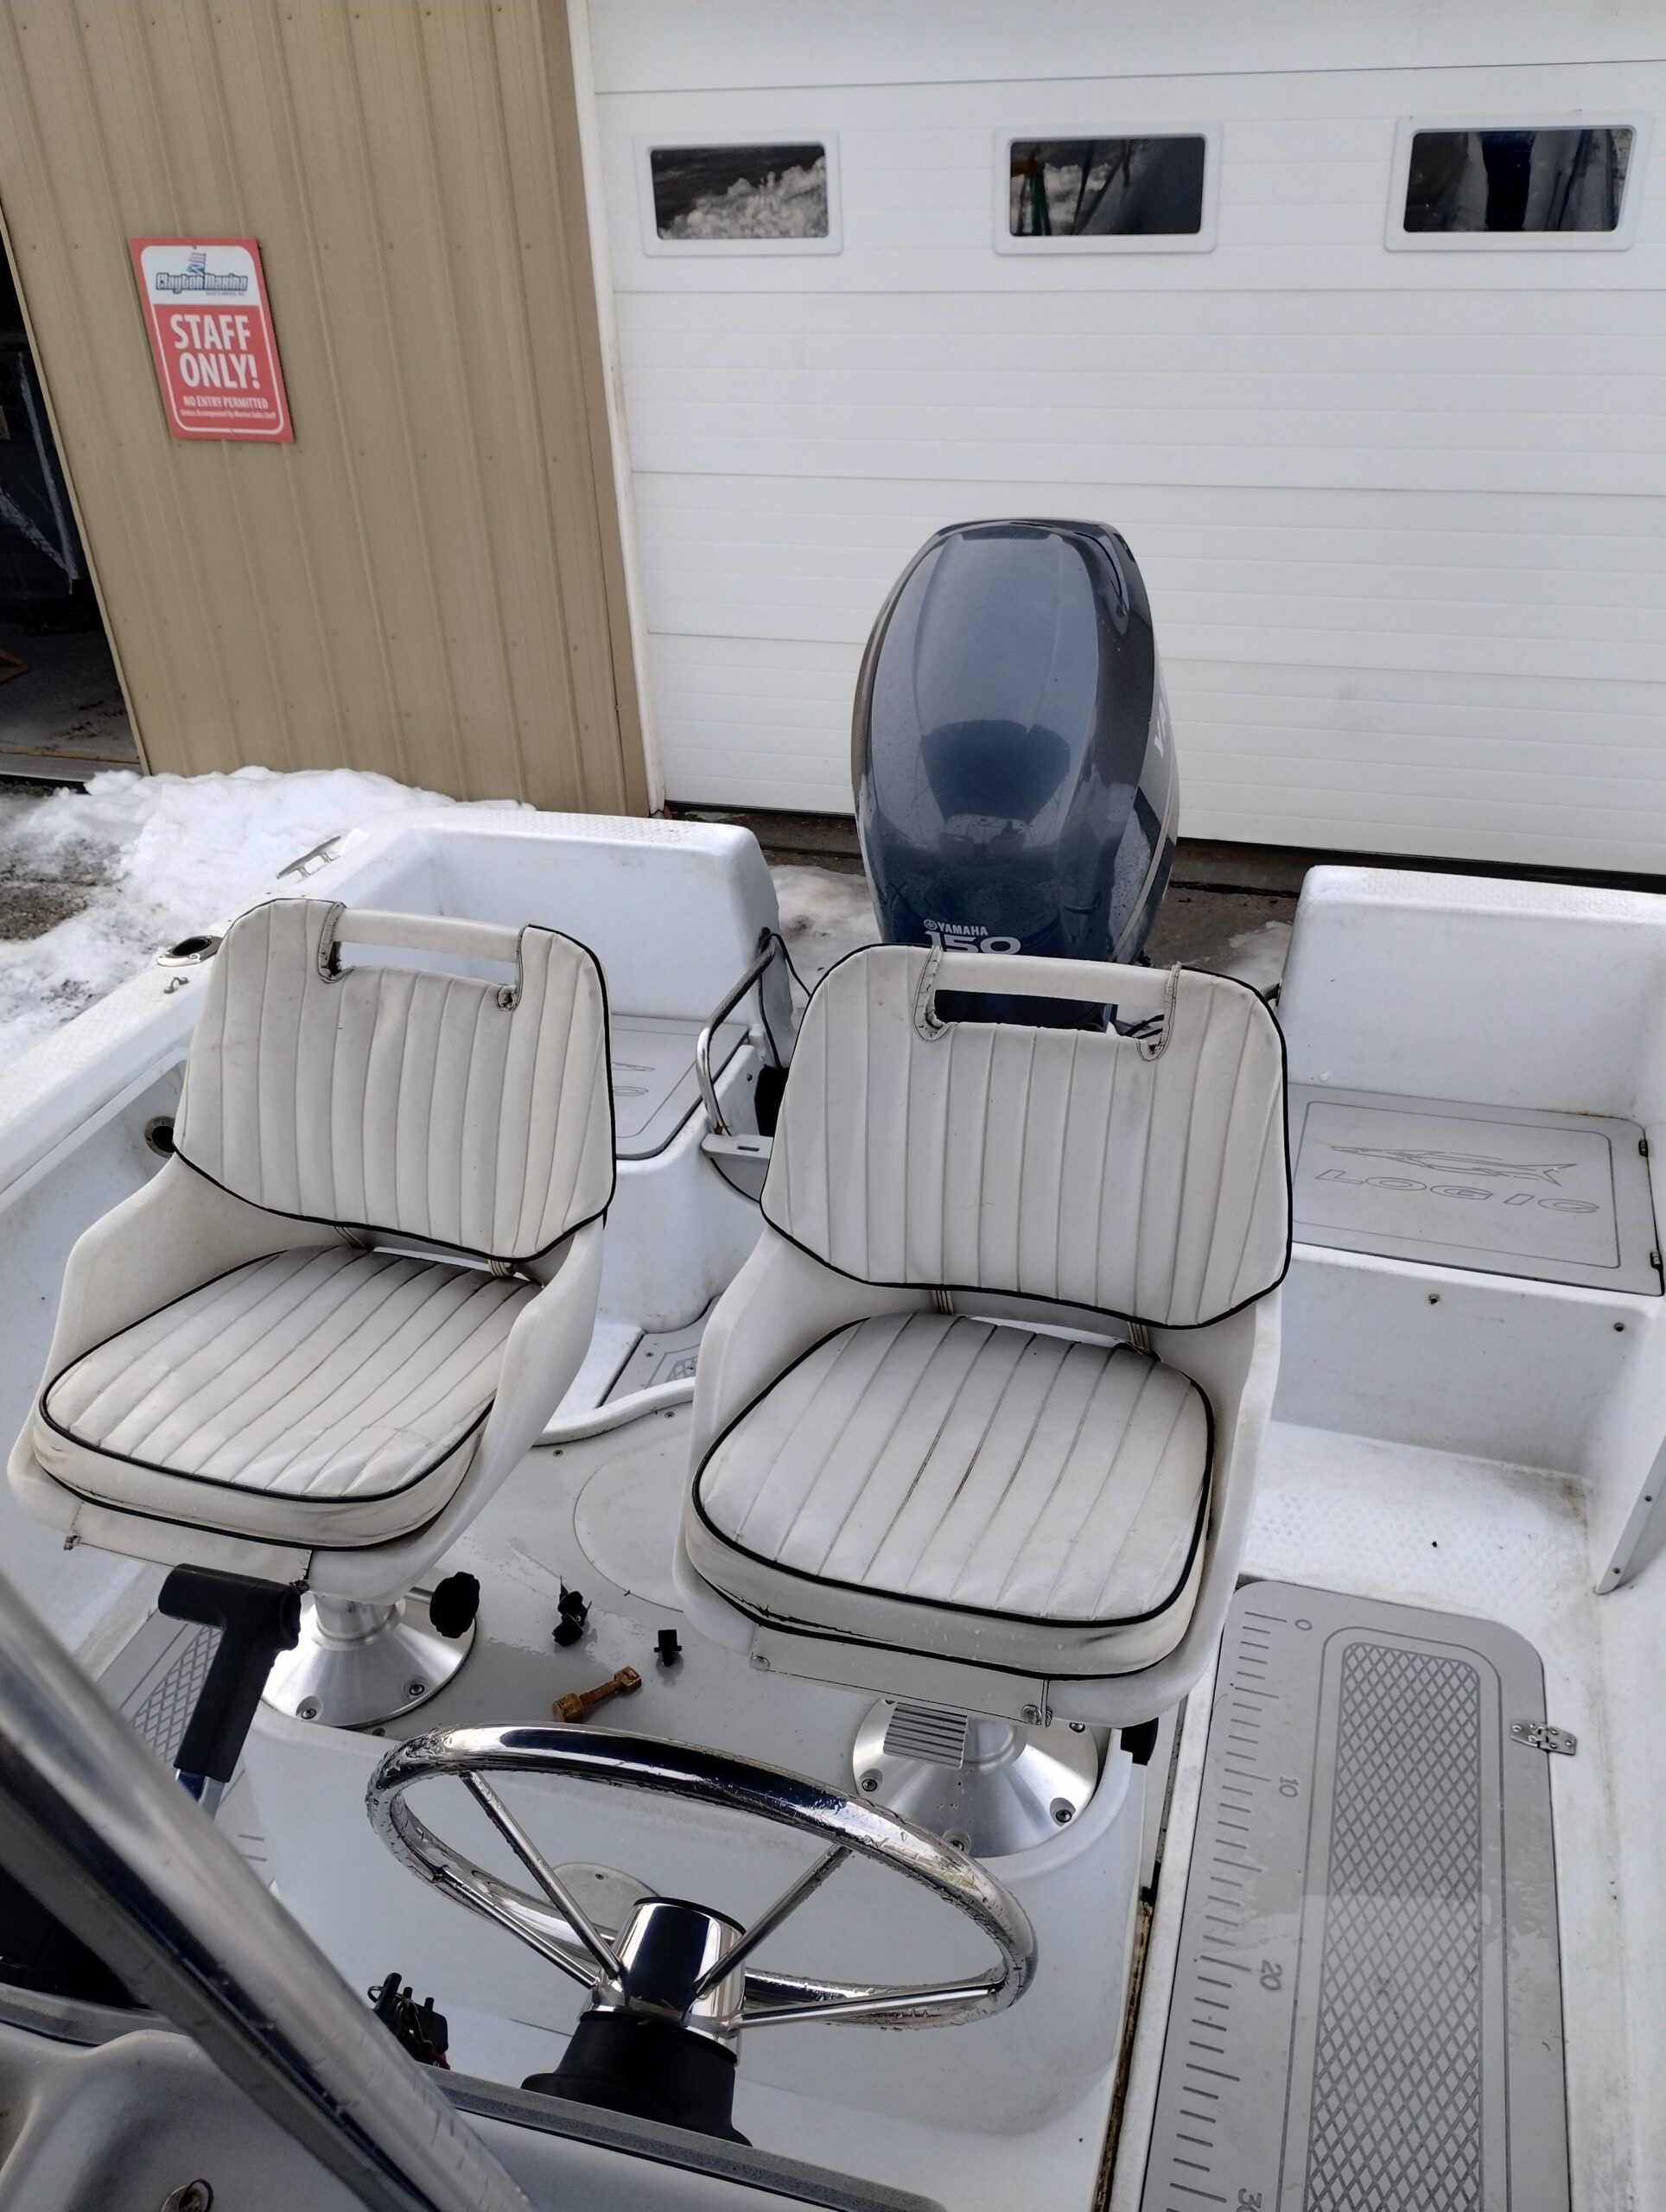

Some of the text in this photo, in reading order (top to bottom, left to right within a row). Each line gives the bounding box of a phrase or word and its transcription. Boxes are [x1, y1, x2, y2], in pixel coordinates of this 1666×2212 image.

[156, 272, 248, 294] Clayton Marina
[170, 314, 251, 351] STAFF
[180, 352, 261, 390] ONLY!
[182, 395, 270, 410] NO ENTRY PERMITTED
[938, 921, 989, 937] YAMAHA
[924, 930, 1021, 955] 150
[1315, 1168, 1600, 1214] LOGIC
[1279, 1776, 1300, 1798] 10
[1259, 1959, 1284, 1992] 20
